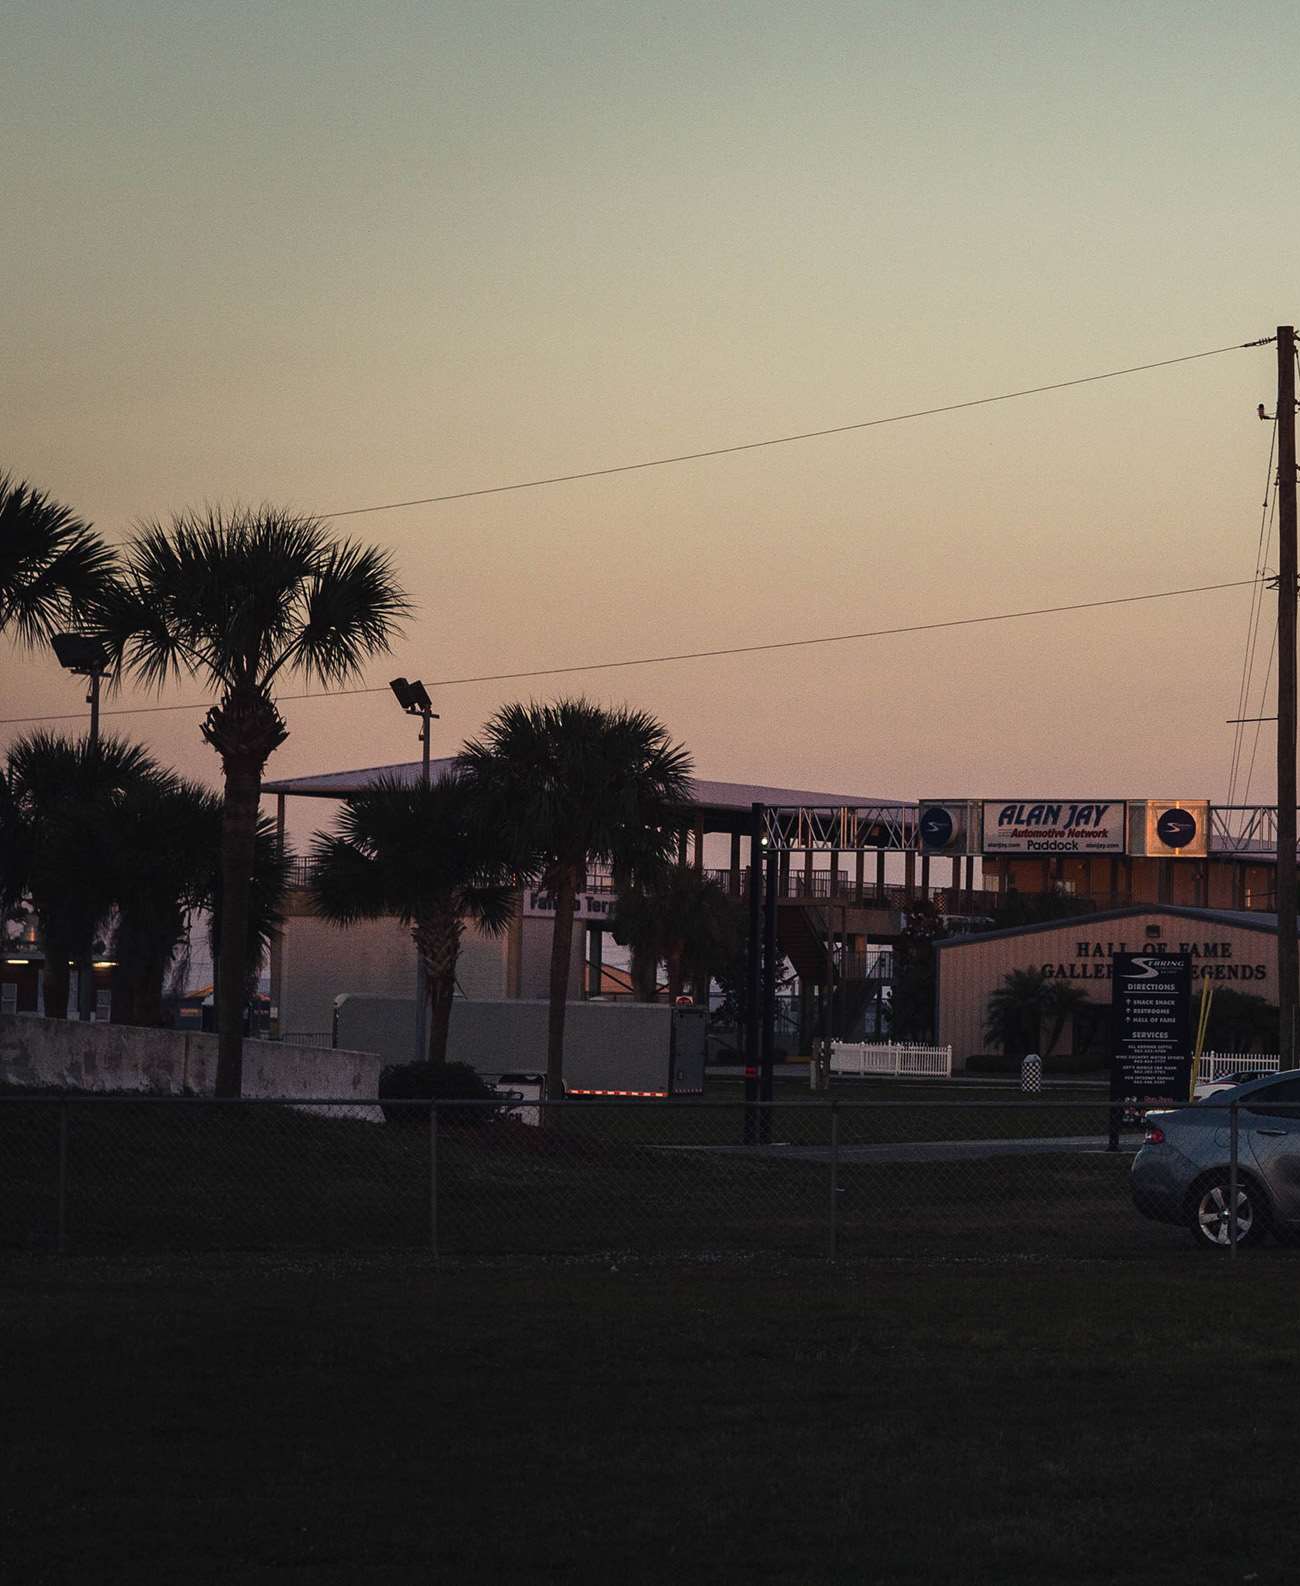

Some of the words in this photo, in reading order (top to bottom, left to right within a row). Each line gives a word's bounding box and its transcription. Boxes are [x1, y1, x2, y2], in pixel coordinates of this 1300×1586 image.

[998, 805, 1063, 827] ALAN
[1063, 805, 1110, 830] JAY
[1011, 828, 1065, 839] Automotive
[1067, 828, 1108, 839] Network
[1027, 840, 1079, 850] Paddock
[1179, 942, 1232, 958] FAME
[1040, 963, 1113, 979] GALLE
[1191, 964, 1266, 980] EGENDS
[1127, 983, 1176, 991] DIRECTIONS
[1132, 1031, 1169, 1039] SERVICES
